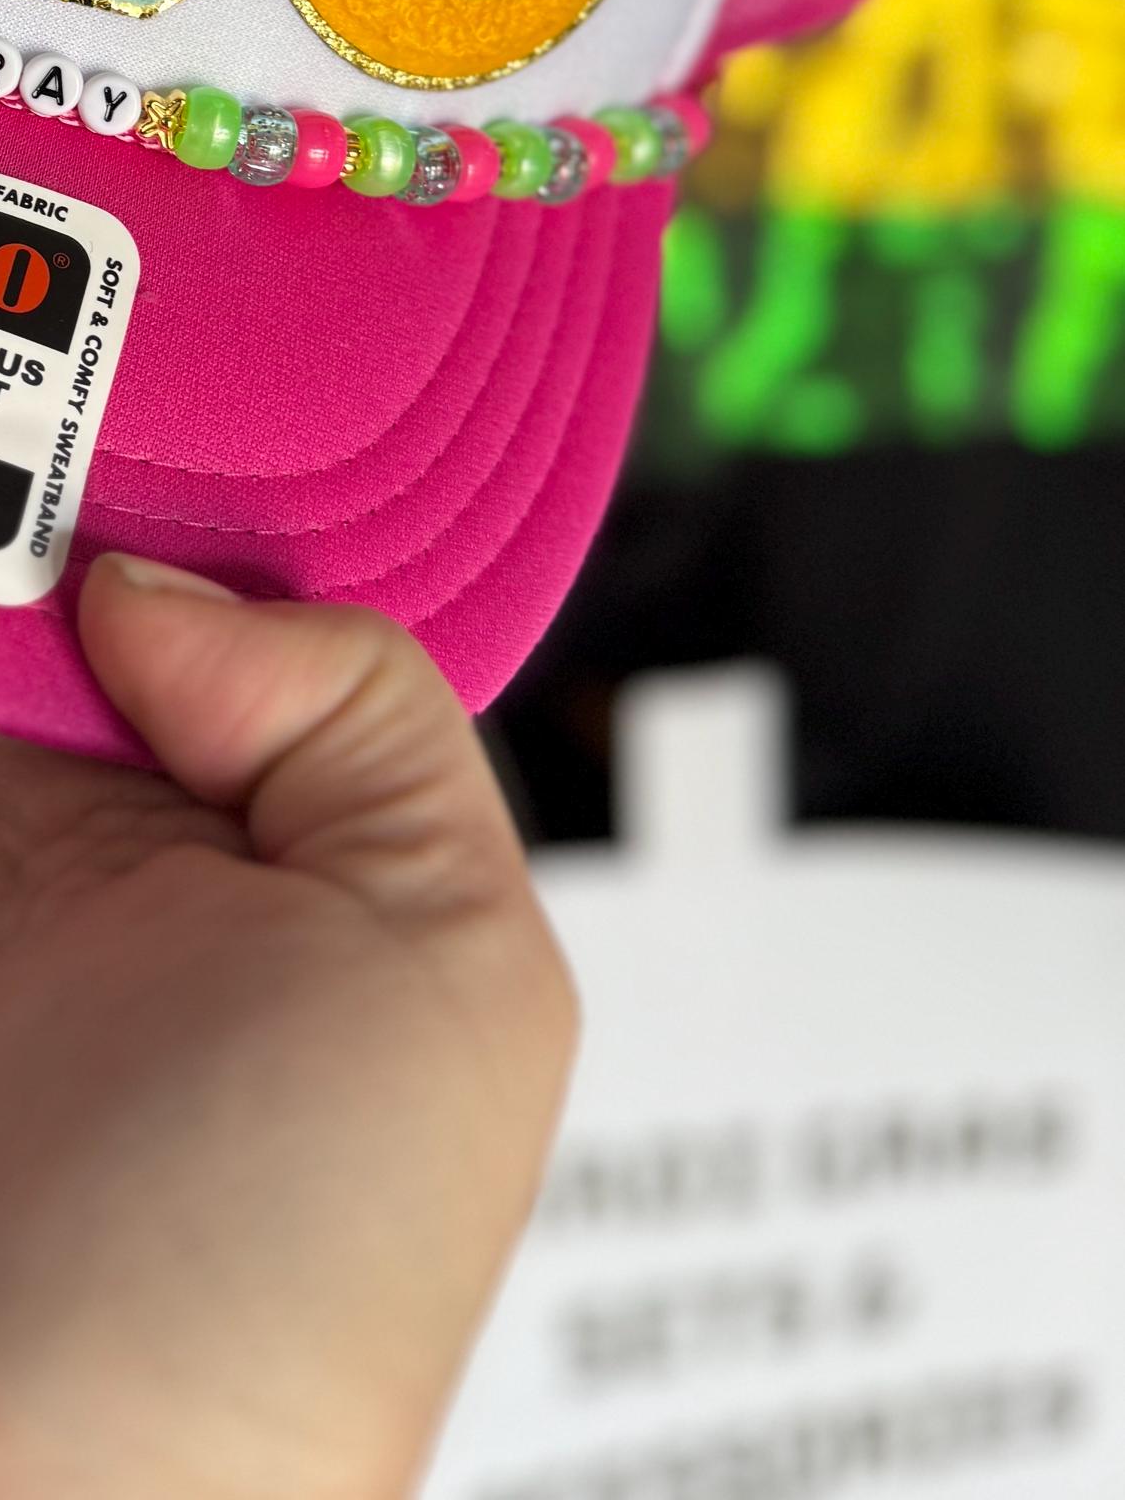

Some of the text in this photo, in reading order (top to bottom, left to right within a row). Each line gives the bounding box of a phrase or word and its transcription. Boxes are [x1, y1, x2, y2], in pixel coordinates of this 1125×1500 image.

[28, 257, 123, 558] SOFT & COMFY SWEATBAND
